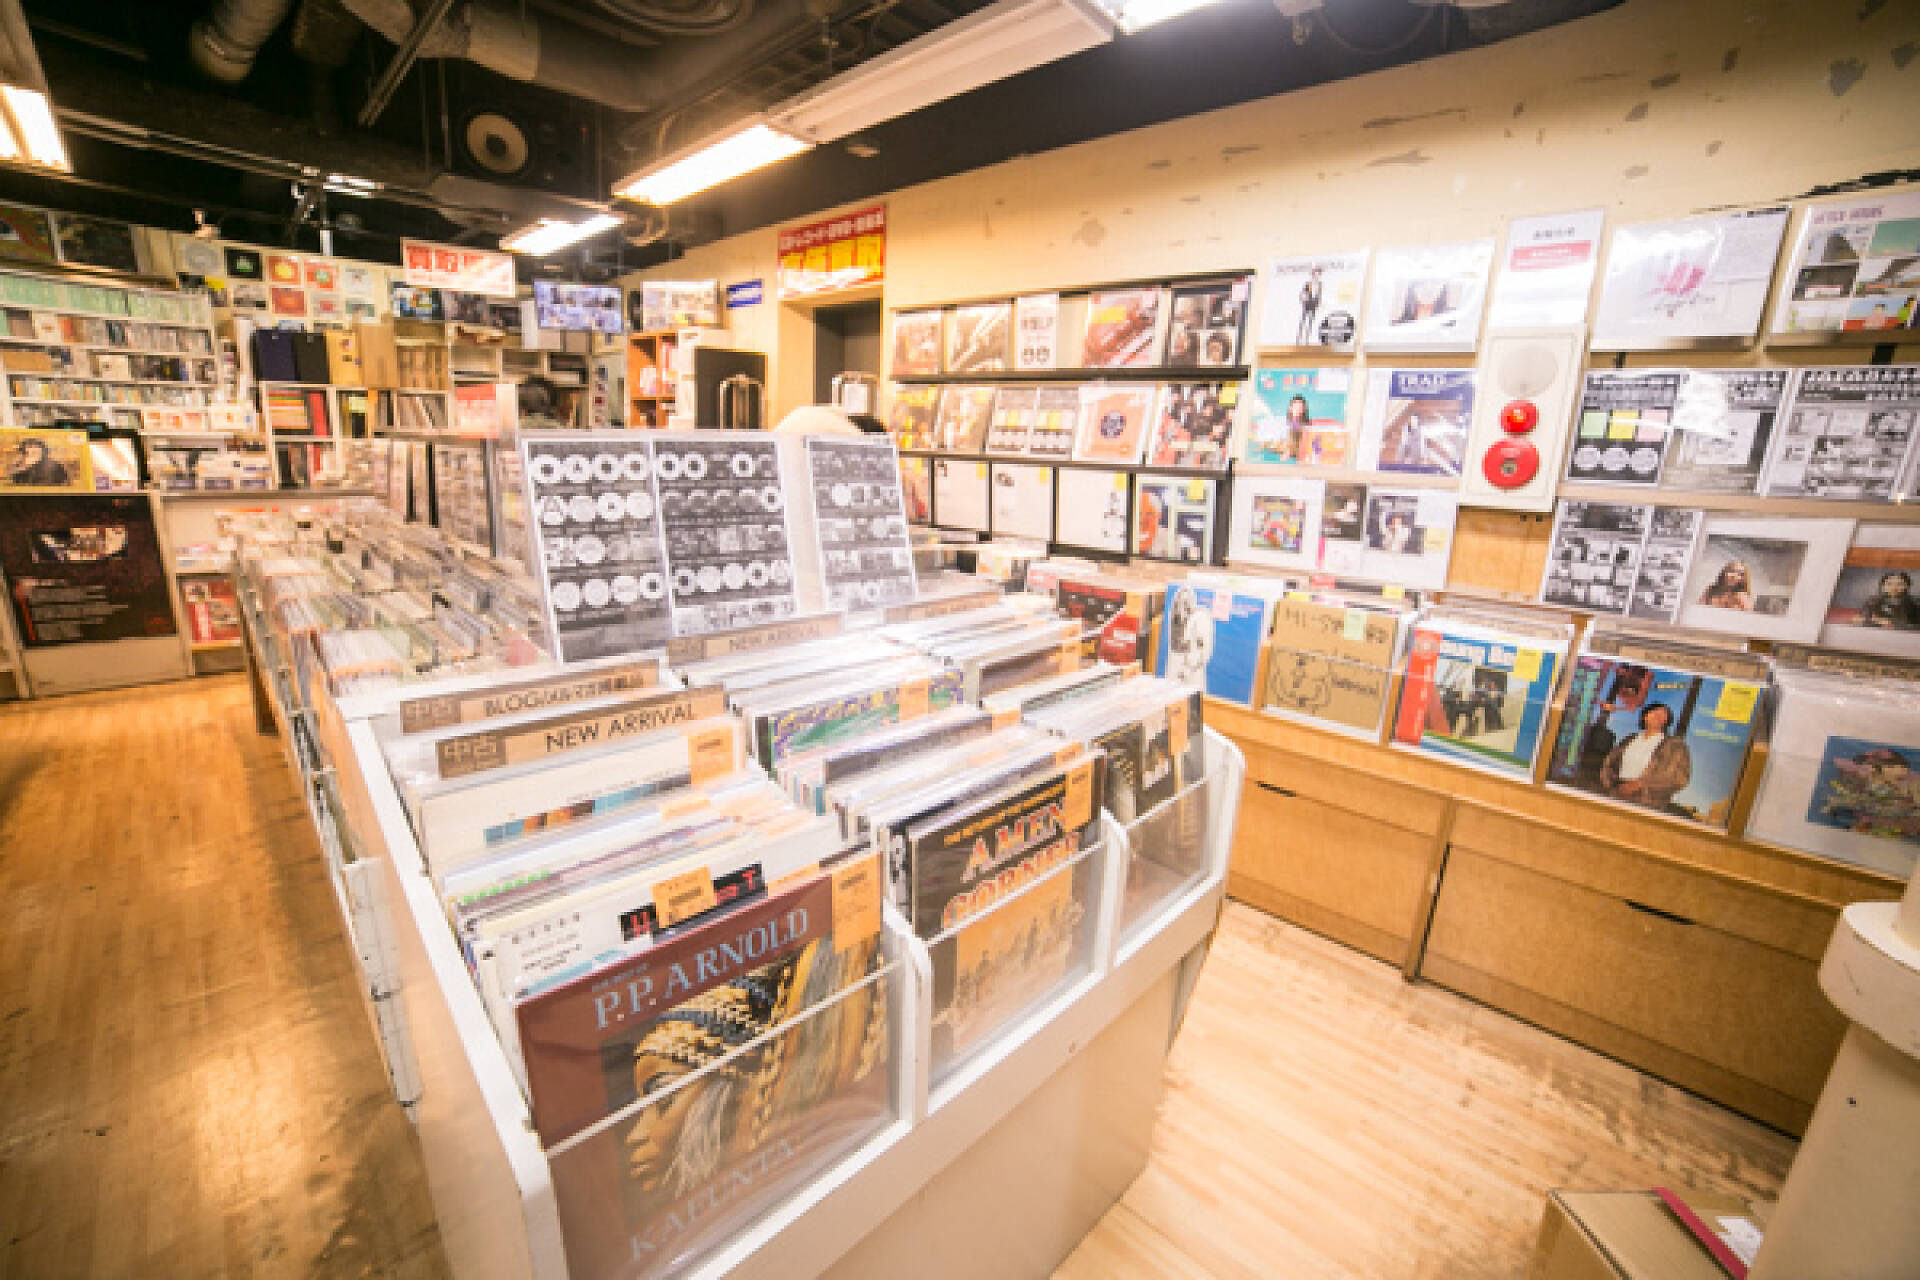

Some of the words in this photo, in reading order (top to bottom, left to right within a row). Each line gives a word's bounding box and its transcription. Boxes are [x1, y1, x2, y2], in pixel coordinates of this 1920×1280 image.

[545, 723, 600, 753] NEW
[606, 702, 698, 738] ARRIVAL
[960, 798, 1067, 883] AMEN
[663, 907, 811, 1000] ARNOLD
